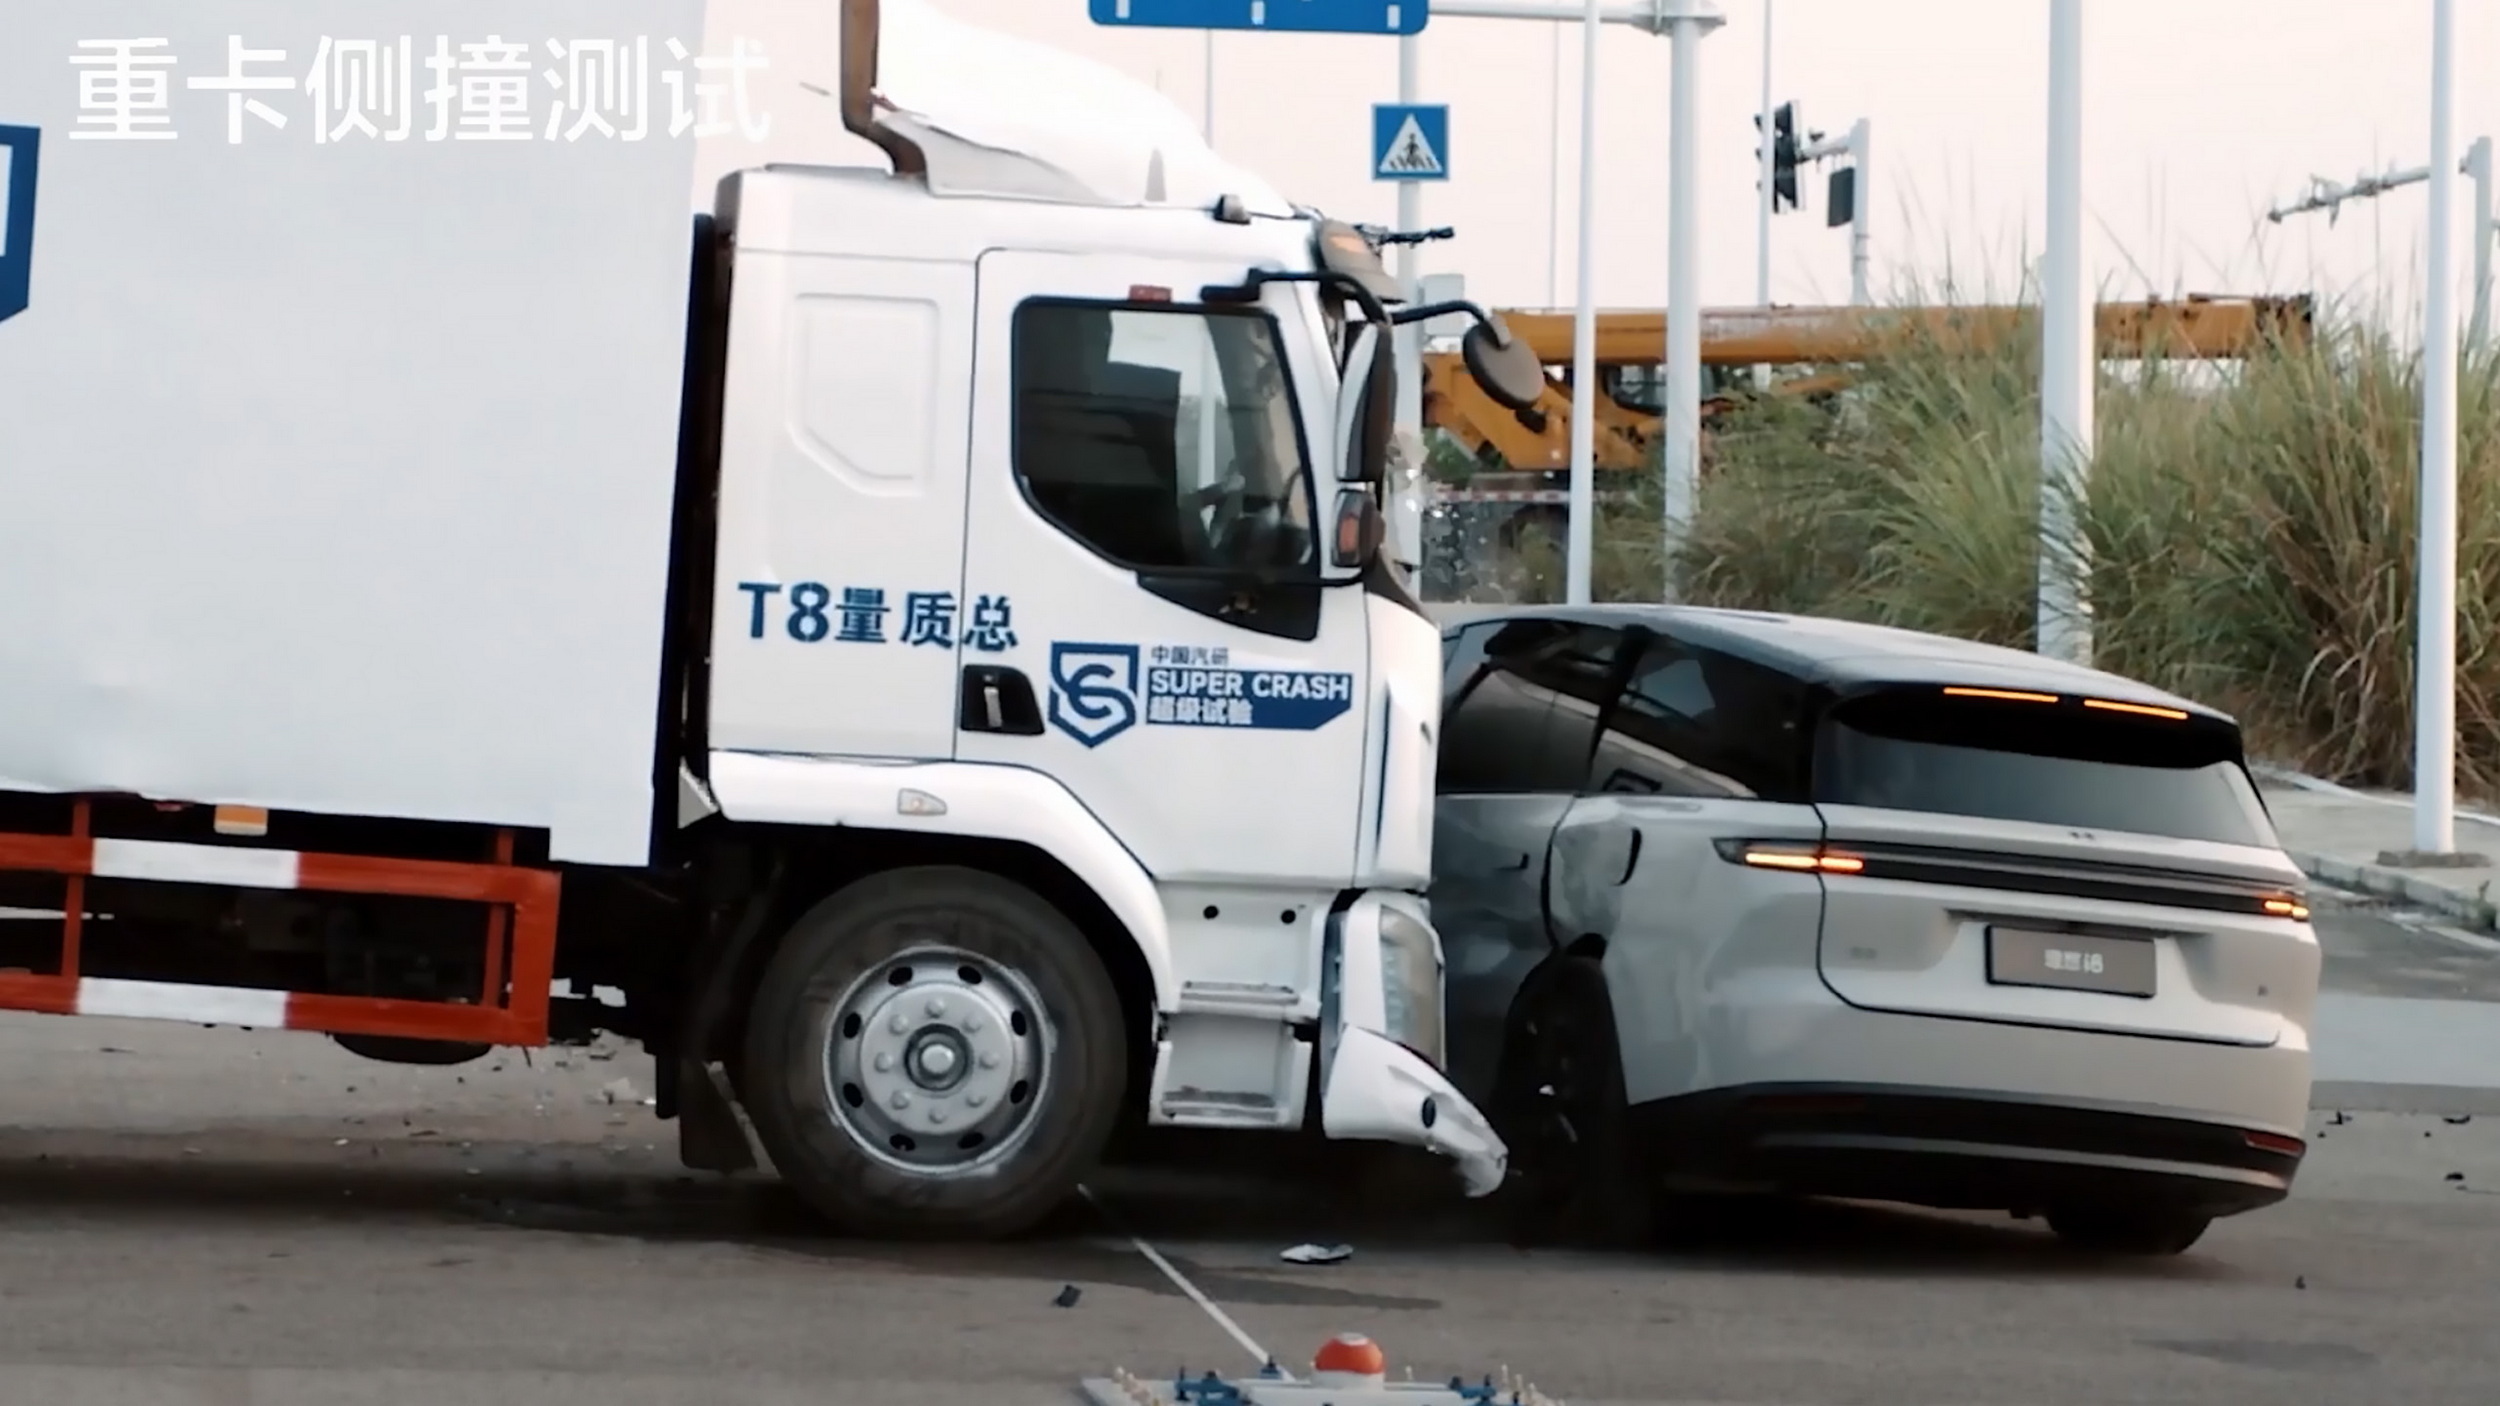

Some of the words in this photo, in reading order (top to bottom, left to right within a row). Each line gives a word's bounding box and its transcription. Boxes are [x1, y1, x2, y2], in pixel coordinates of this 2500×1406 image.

[1151, 645, 1229, 665] 中国汽研
[1151, 670, 1243, 696] SUPER
[1251, 673, 1350, 701] CRASH
[1149, 696, 1252, 724] 超级试验
